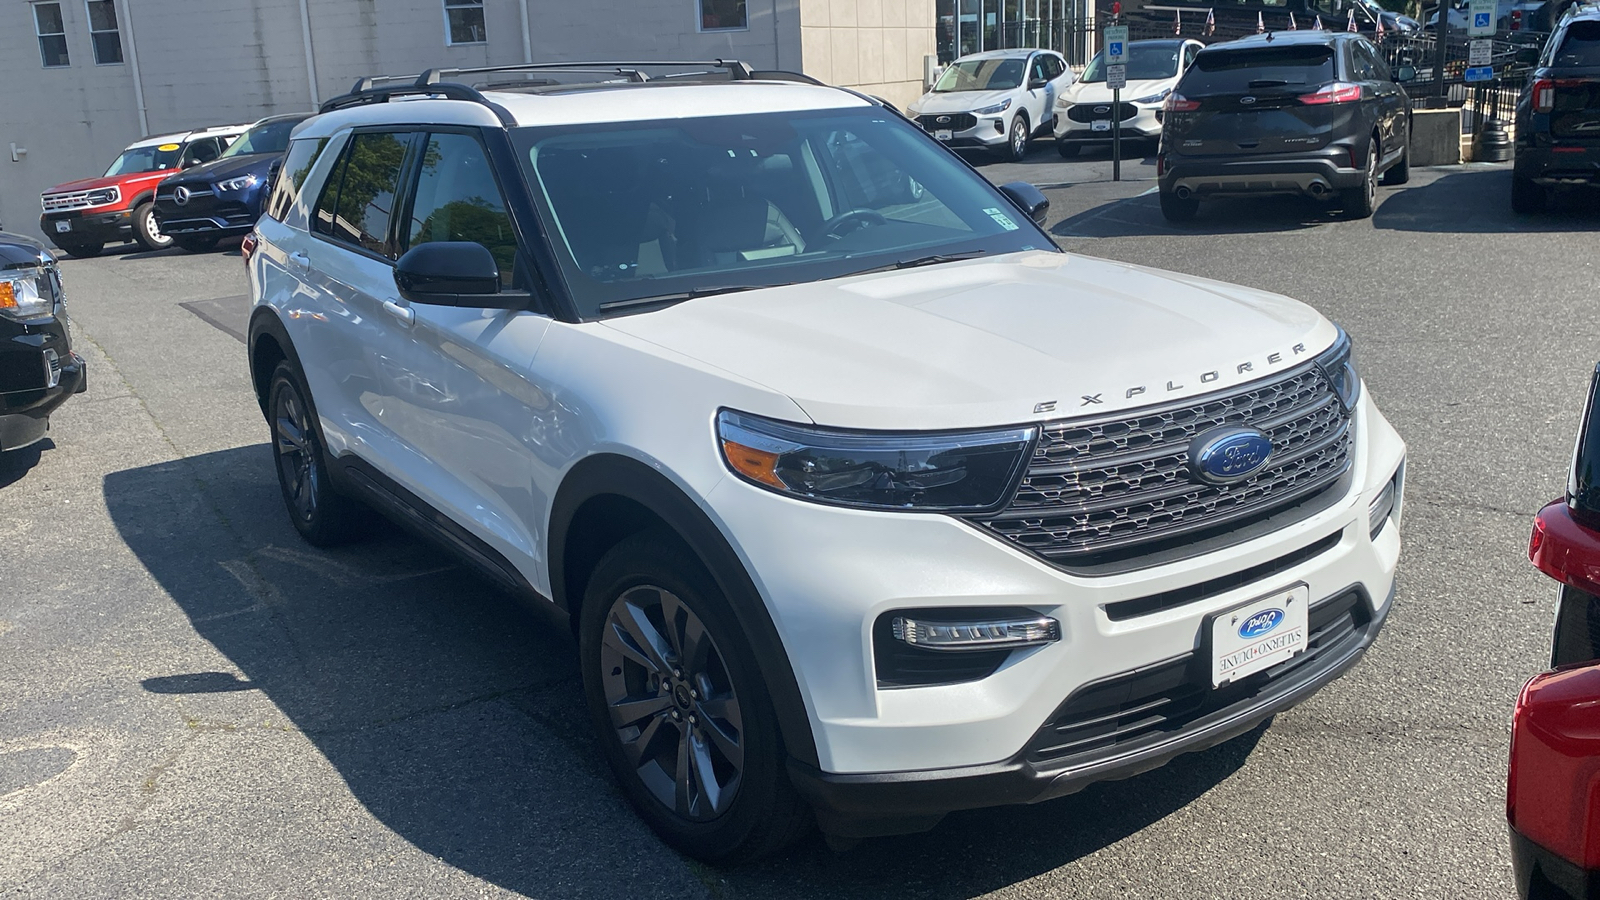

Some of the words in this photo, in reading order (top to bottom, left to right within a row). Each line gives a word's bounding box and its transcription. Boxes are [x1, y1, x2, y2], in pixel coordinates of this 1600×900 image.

[1033, 342, 1306, 414] EXPLORER
[1222, 442, 1260, 472] Ford
[1246, 611, 1276, 634] Ford
[1258, 629, 1302, 655] SALERNO
[1220, 648, 1254, 671] DUANE
